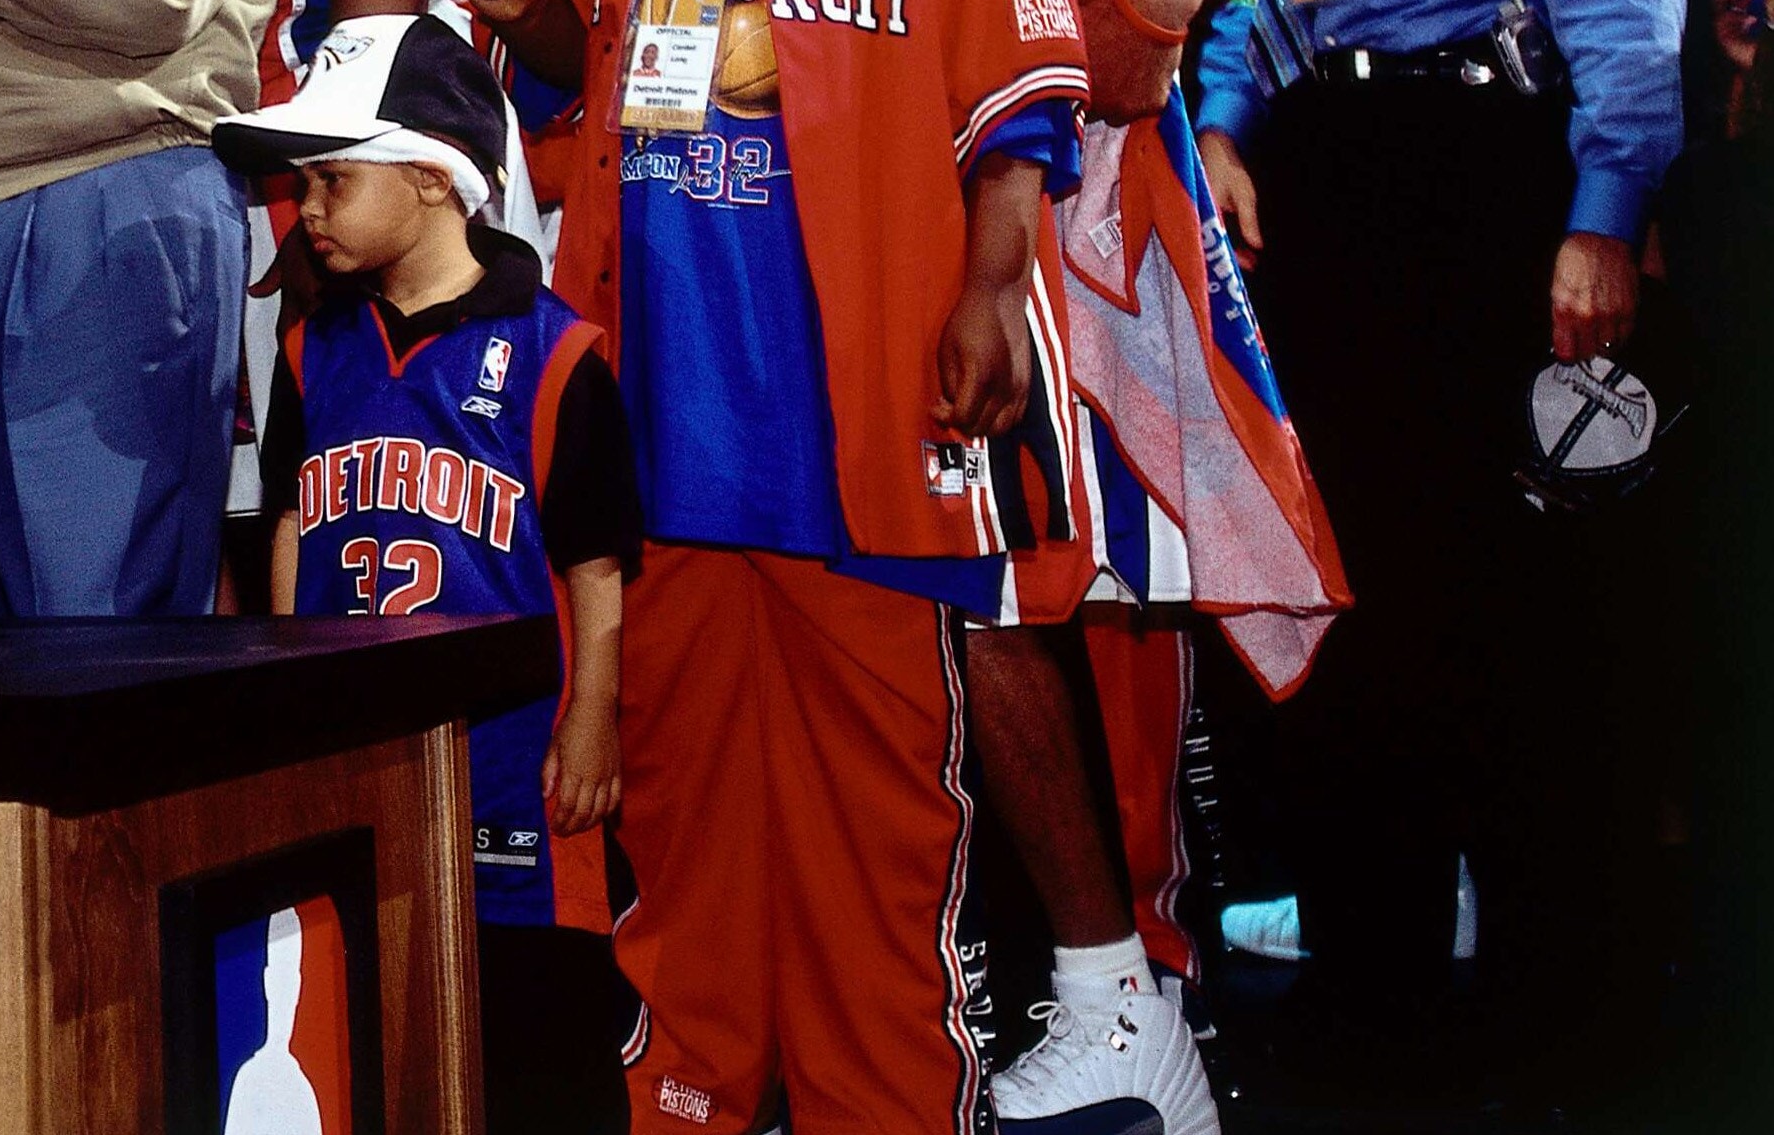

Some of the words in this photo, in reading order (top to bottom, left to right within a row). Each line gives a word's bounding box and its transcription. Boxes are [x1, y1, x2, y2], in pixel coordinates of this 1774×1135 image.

[1016, 8, 1078, 35] PISTONS
[297, 436, 526, 554] DETROIT
[341, 536, 443, 616] 32
[476, 827, 490, 849] S
[660, 1087, 710, 1119] PISTONS
